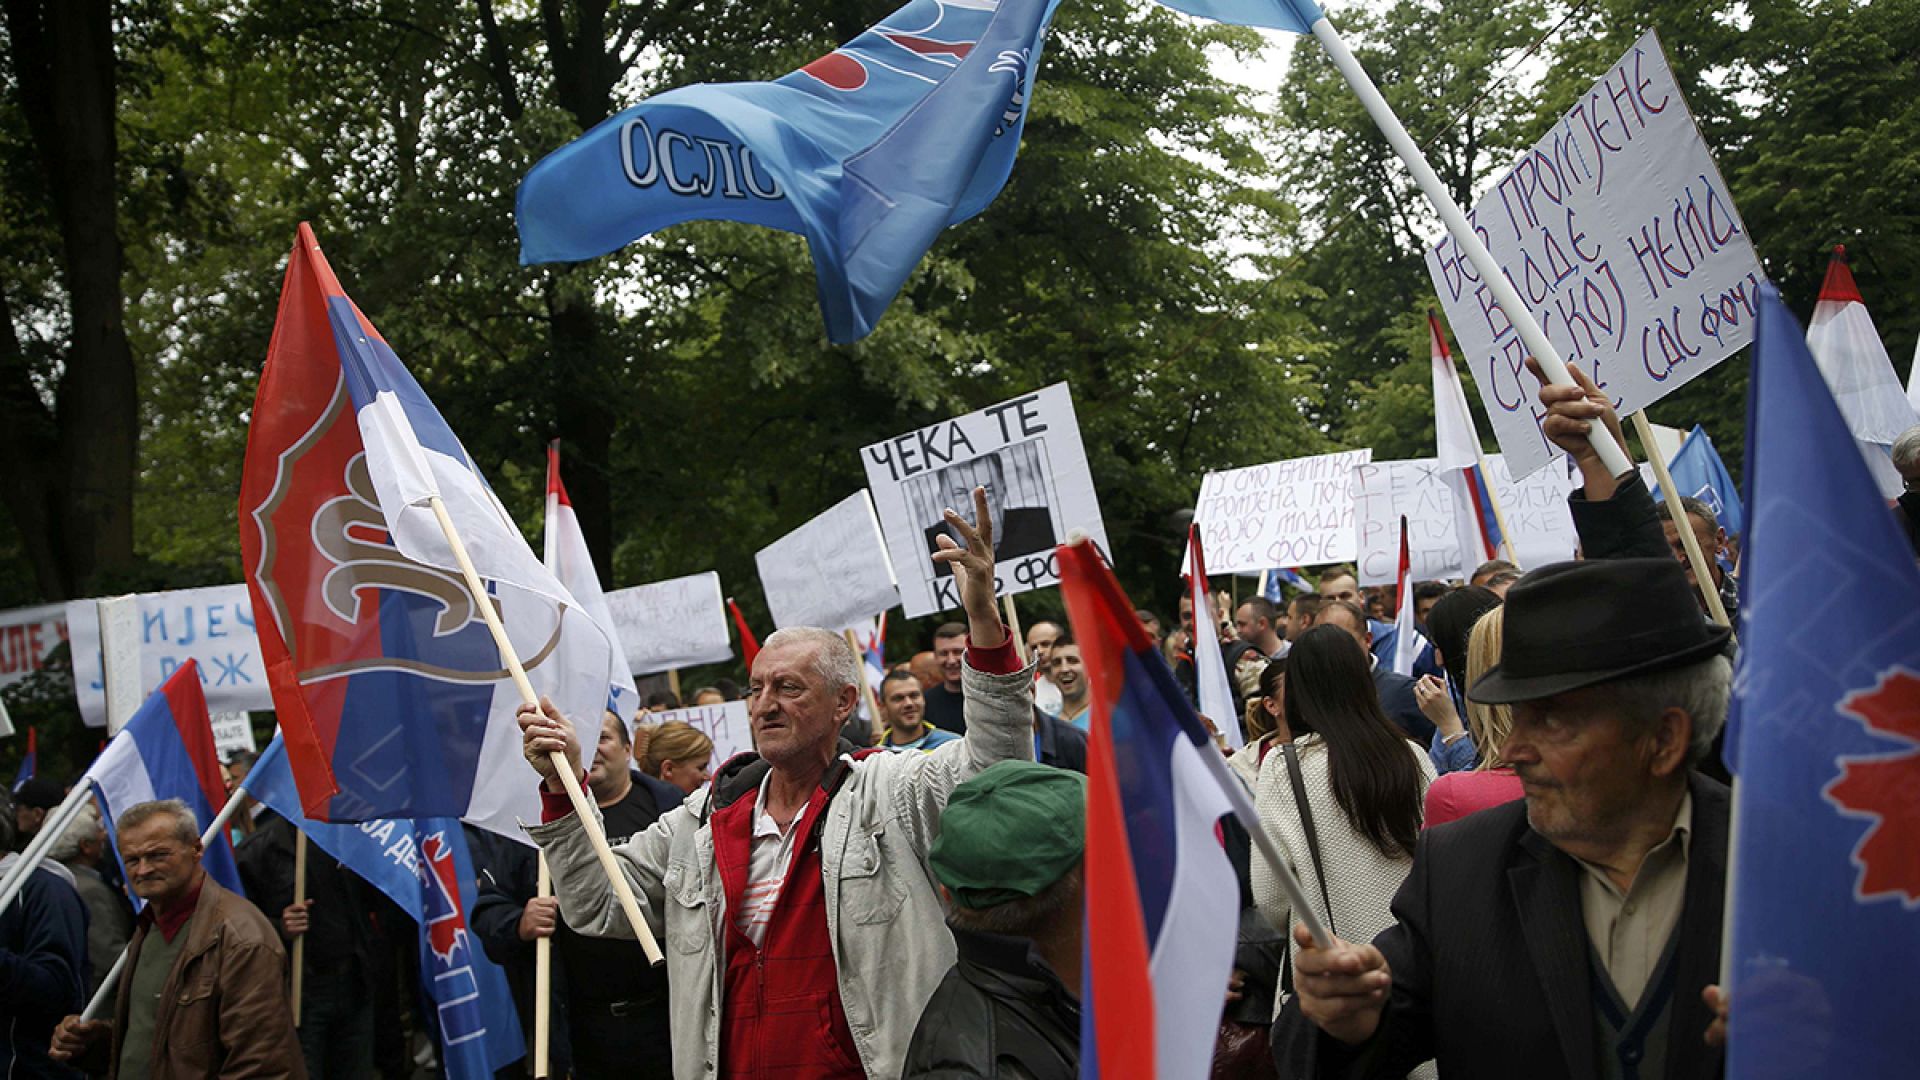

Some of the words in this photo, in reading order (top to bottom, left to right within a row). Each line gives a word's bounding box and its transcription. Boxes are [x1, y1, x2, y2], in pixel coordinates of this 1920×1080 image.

[620, 116, 786, 200] ОСЛО
[1490, 260, 1629, 413] СРКОЈ
[1642, 305, 1702, 381] СДС
[869, 420, 976, 482] ЧЕКА
[984, 394, 1048, 443] ТЕ
[1267, 533, 1338, 565] ФОЧЕ
